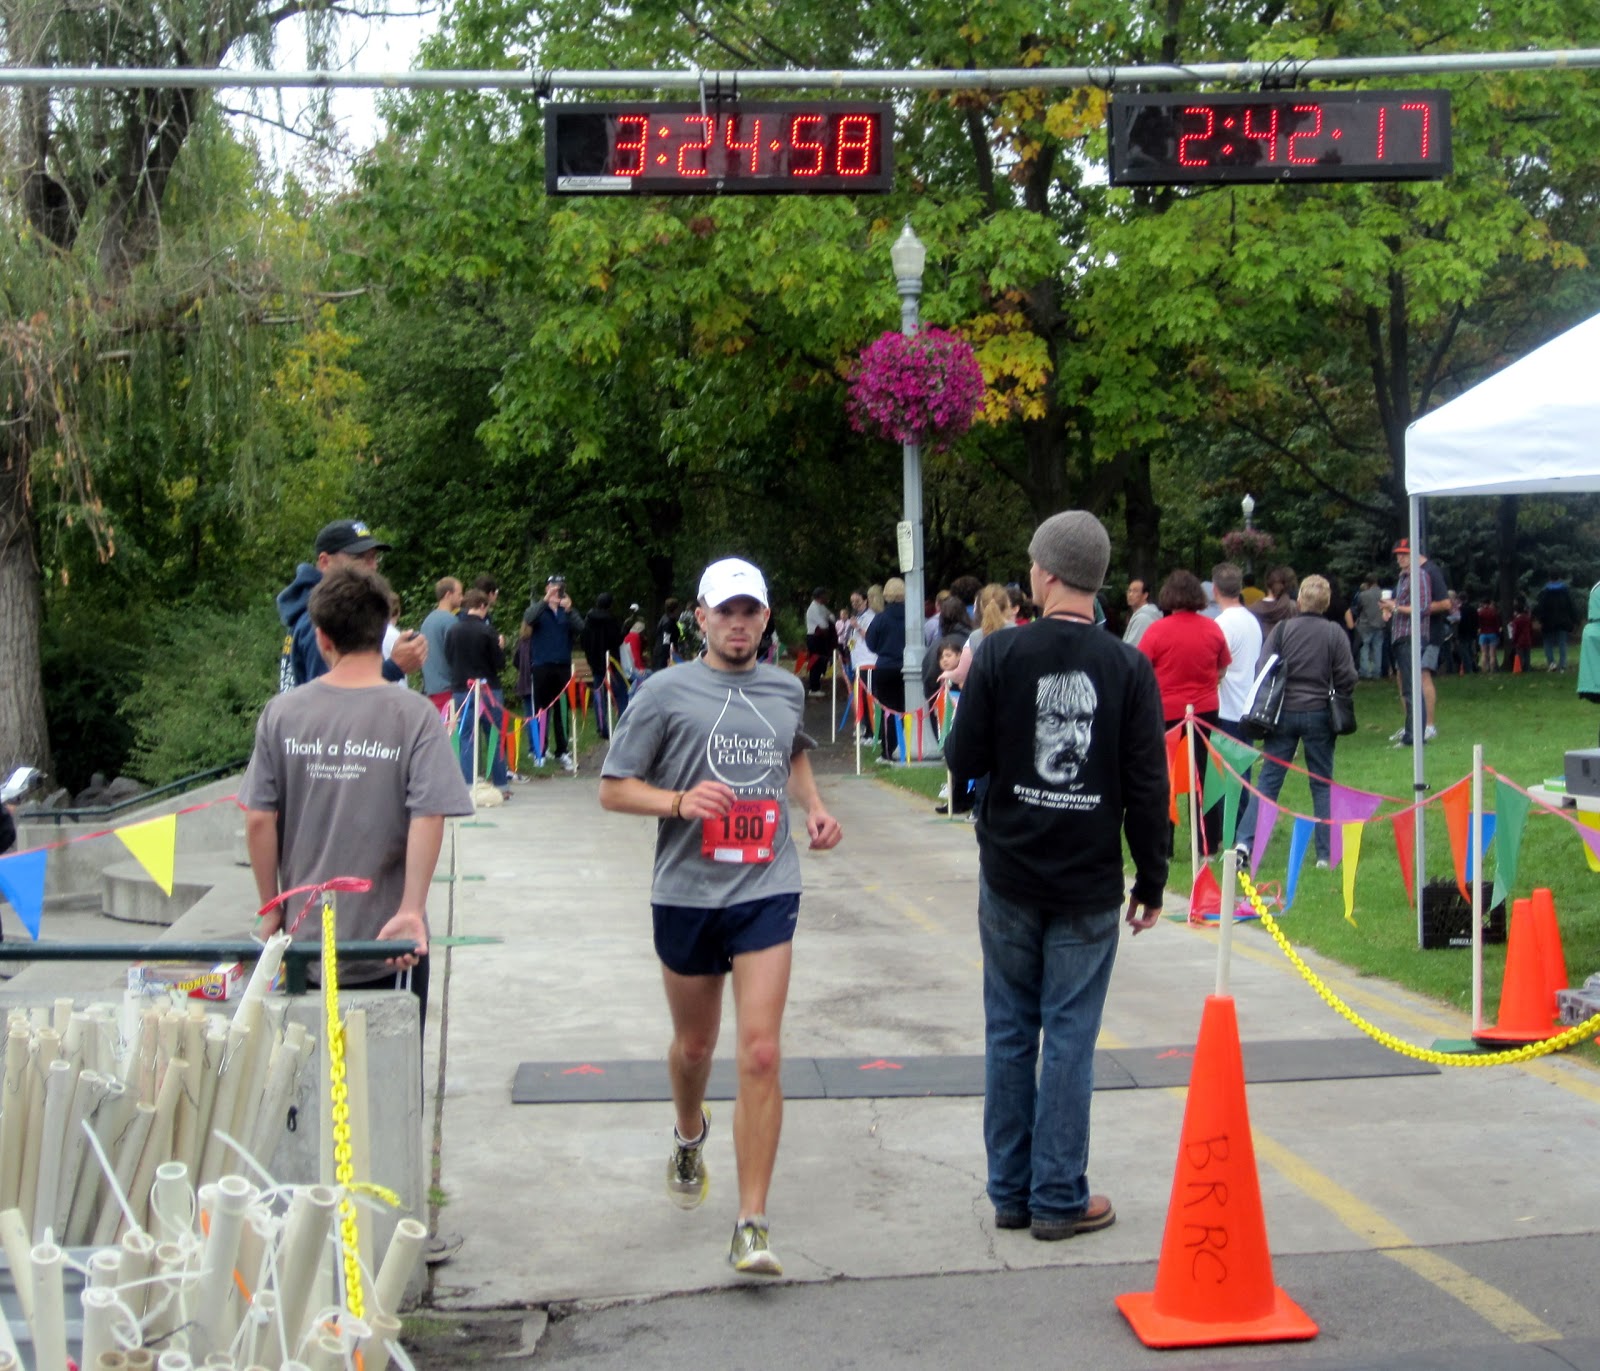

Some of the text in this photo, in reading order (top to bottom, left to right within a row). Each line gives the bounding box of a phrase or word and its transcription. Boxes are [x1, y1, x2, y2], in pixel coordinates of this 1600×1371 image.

[284, 738, 401, 761] Thank a Soldier!
[713, 733, 775, 749] Palouse
[717, 749, 753, 765] Falls
[1013, 784, 1102, 804] STEVE PREFONTAINE
[720, 815, 764, 841] 190
[1183, 1133, 1230, 1284] BRRC
